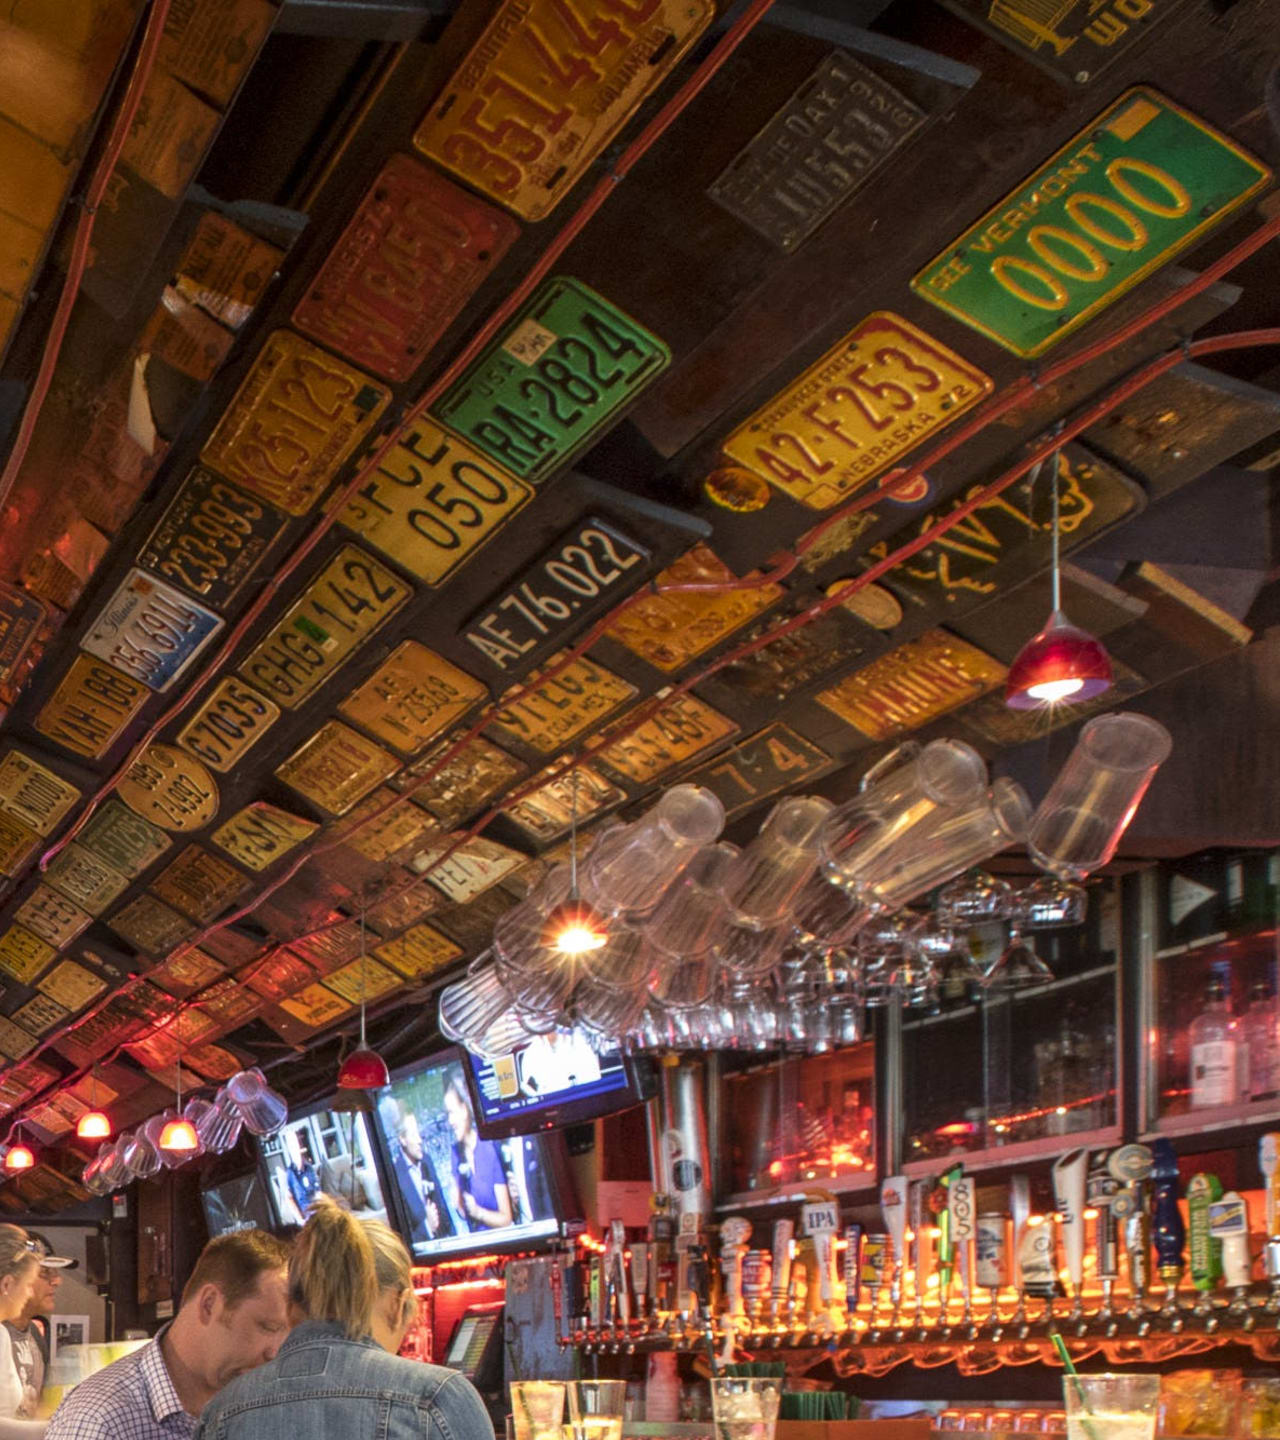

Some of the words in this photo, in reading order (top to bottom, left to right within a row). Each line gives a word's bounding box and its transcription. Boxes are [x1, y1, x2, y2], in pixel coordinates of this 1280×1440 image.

[930, 256, 972, 291] SEE
[971, 142, 1102, 252] VERMONT
[992, 157, 1190, 311] 0000
[476, 360, 517, 398] USA
[845, 411, 936, 481] NEBRASKA
[160, 483, 263, 595] 233-993
[407, 461, 509, 551] 050
[251, 631, 325, 699] GHG
[808, 1208, 835, 1228] IPA
[954, 1184, 971, 1236] 805
